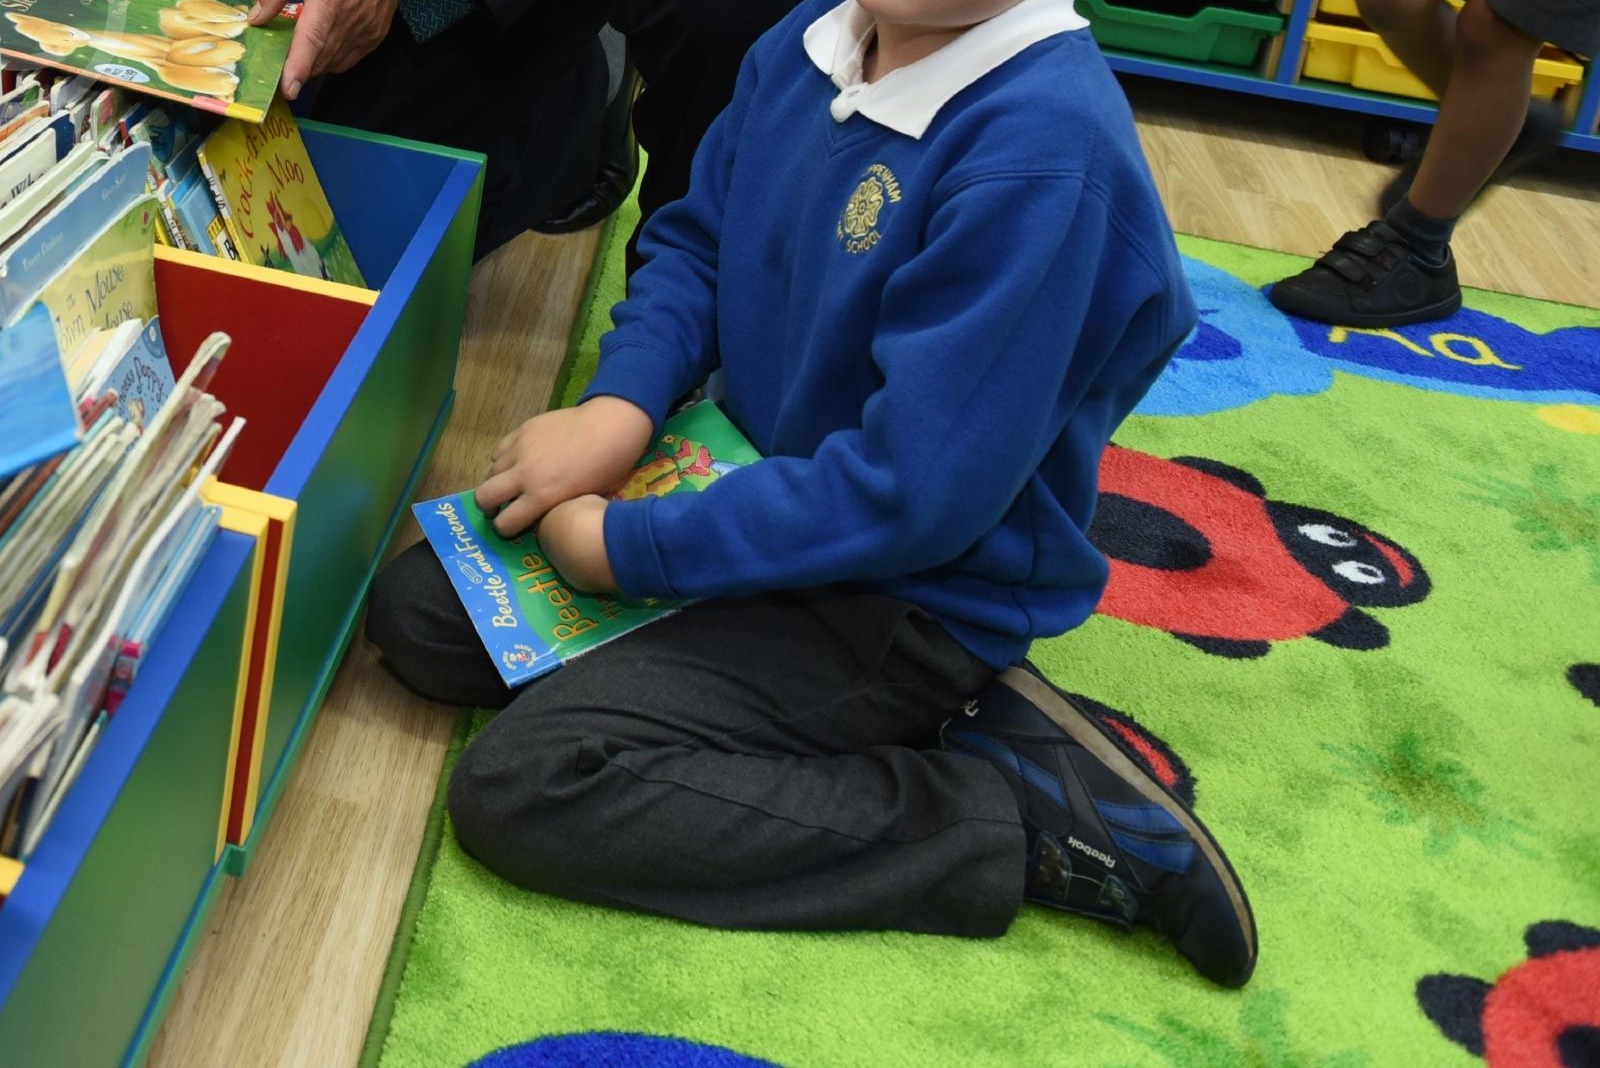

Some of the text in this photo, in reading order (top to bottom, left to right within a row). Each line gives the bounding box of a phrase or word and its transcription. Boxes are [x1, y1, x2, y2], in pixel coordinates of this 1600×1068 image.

[265, 152, 304, 193] Moo
[847, 229, 882, 254] SCHOOL
[84, 262, 125, 312] Mouse
[434, 500, 480, 556] Friends
[490, 575, 518, 629] Beetle
[517, 551, 600, 642] Beetle
[1067, 836, 1117, 869] Reebok
